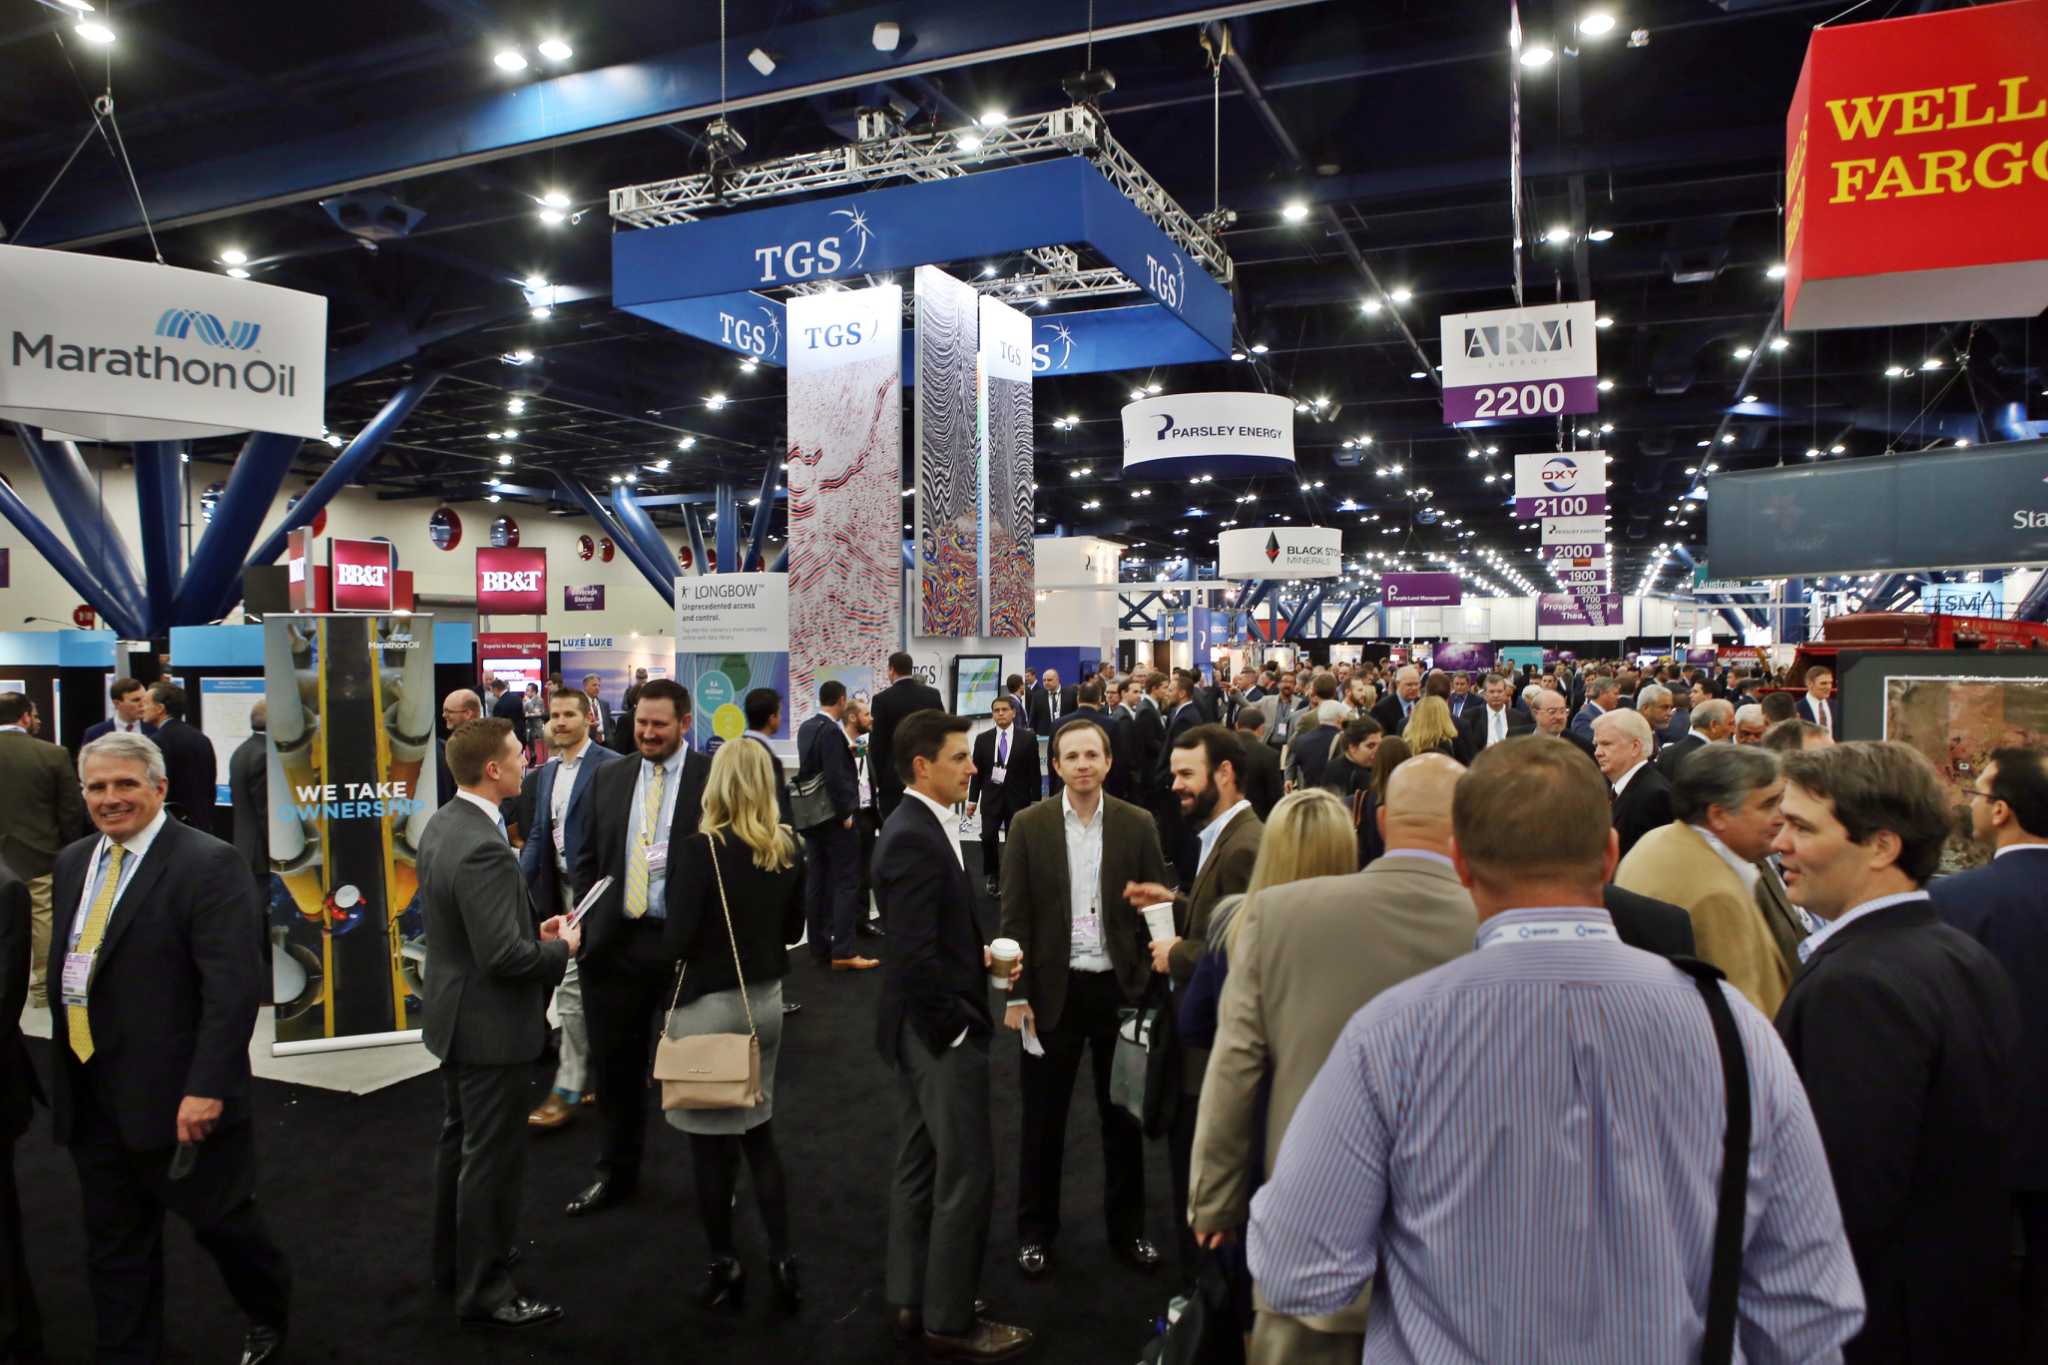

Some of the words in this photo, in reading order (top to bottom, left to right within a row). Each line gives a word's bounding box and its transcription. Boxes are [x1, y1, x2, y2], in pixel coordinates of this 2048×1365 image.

[1825, 76, 2046, 141] WELL
[755, 237, 842, 282] TGS
[1146, 253, 1176, 308] TGS
[720, 312, 766, 355] TGS
[804, 322, 862, 349] TGS
[1465, 319, 1574, 359] ARM
[1000, 340, 1022, 366] TGS
[1474, 382, 1566, 418] 2200
[1172, 426, 1235, 438] PARSLEY
[1240, 426, 1282, 439] ENERGY
[1542, 470, 1578, 480] OXY
[1534, 497, 1588, 517] 2100
[1287, 546, 1323, 555] BLACK
[1554, 545, 1592, 558] 2000
[337, 564, 388, 587] BB&T
[481, 571, 541, 592] BB&T
[1569, 571, 1596, 581] 1900
[695, 584, 758, 600] LONGBOW
[1576, 586, 1598, 594] 1800
[295, 784, 338, 802] WE
[344, 781, 408, 800] TAKE
[277, 798, 427, 822] OWNERSHIP
